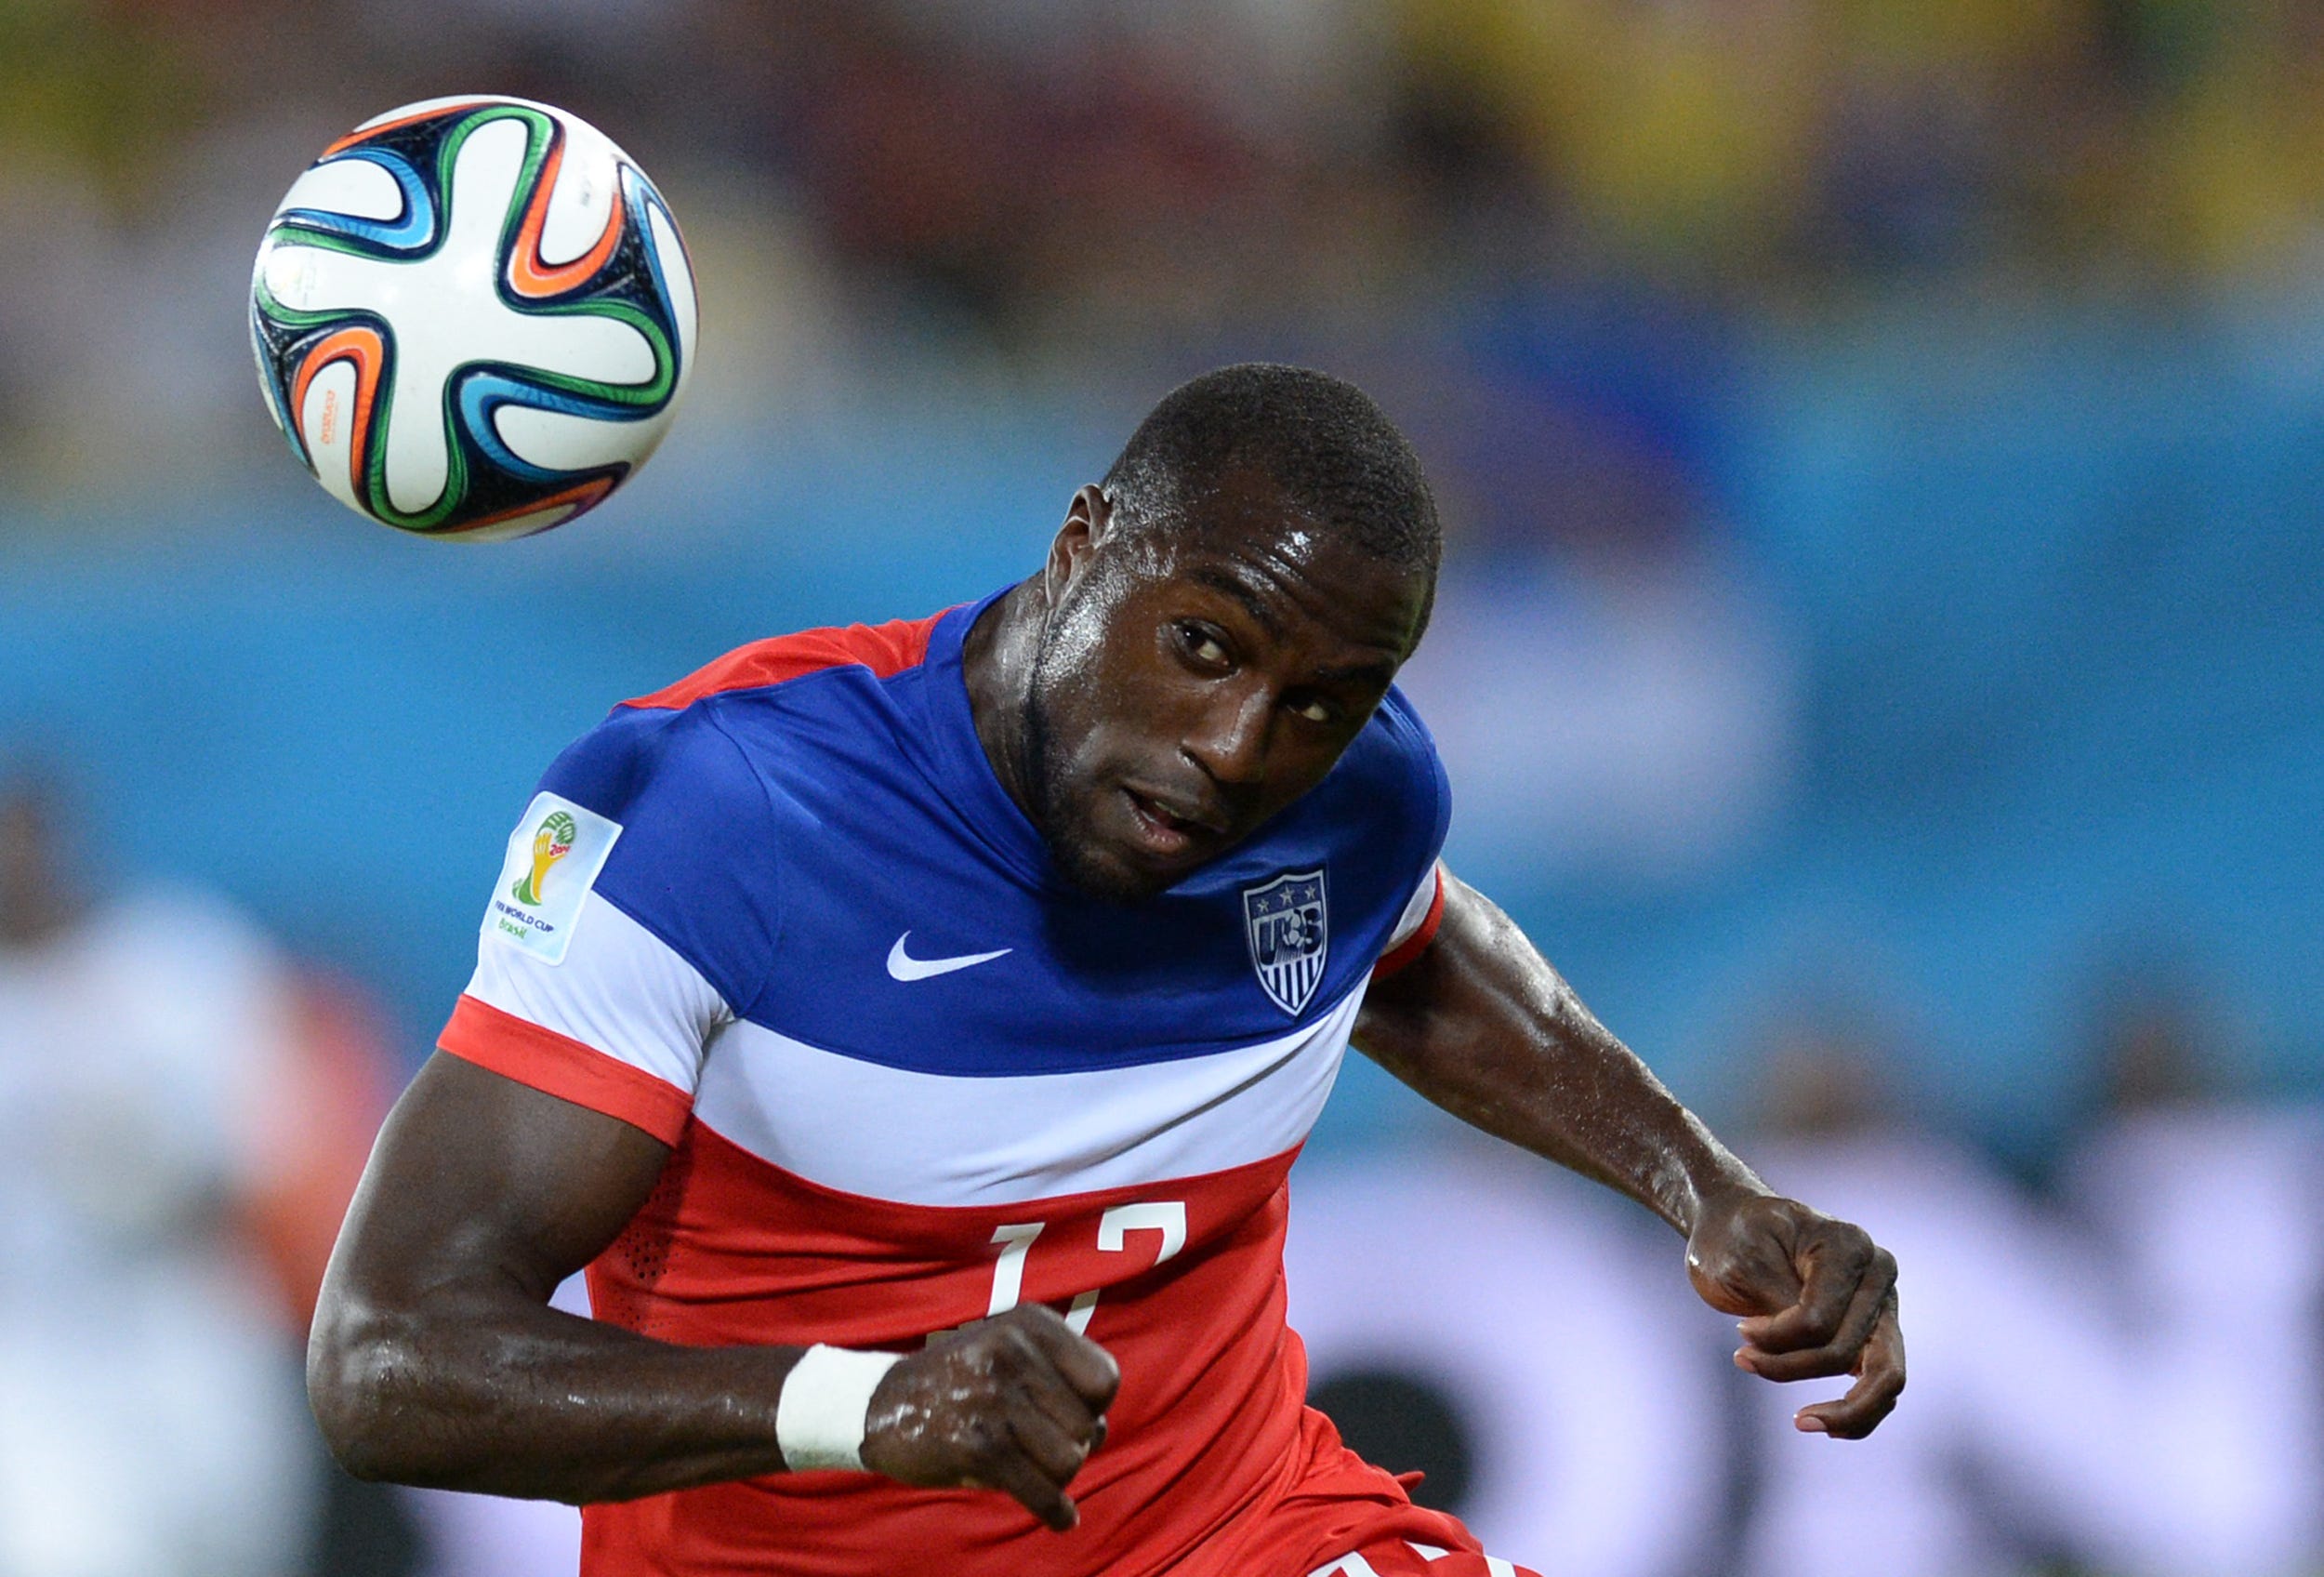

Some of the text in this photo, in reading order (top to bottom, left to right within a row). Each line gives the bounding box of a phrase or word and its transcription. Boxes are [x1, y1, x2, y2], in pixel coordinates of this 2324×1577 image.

[505, 906, 535, 925] WORLD
[535, 920, 554, 933] CUP
[926, 1201, 1187, 1348] 17
